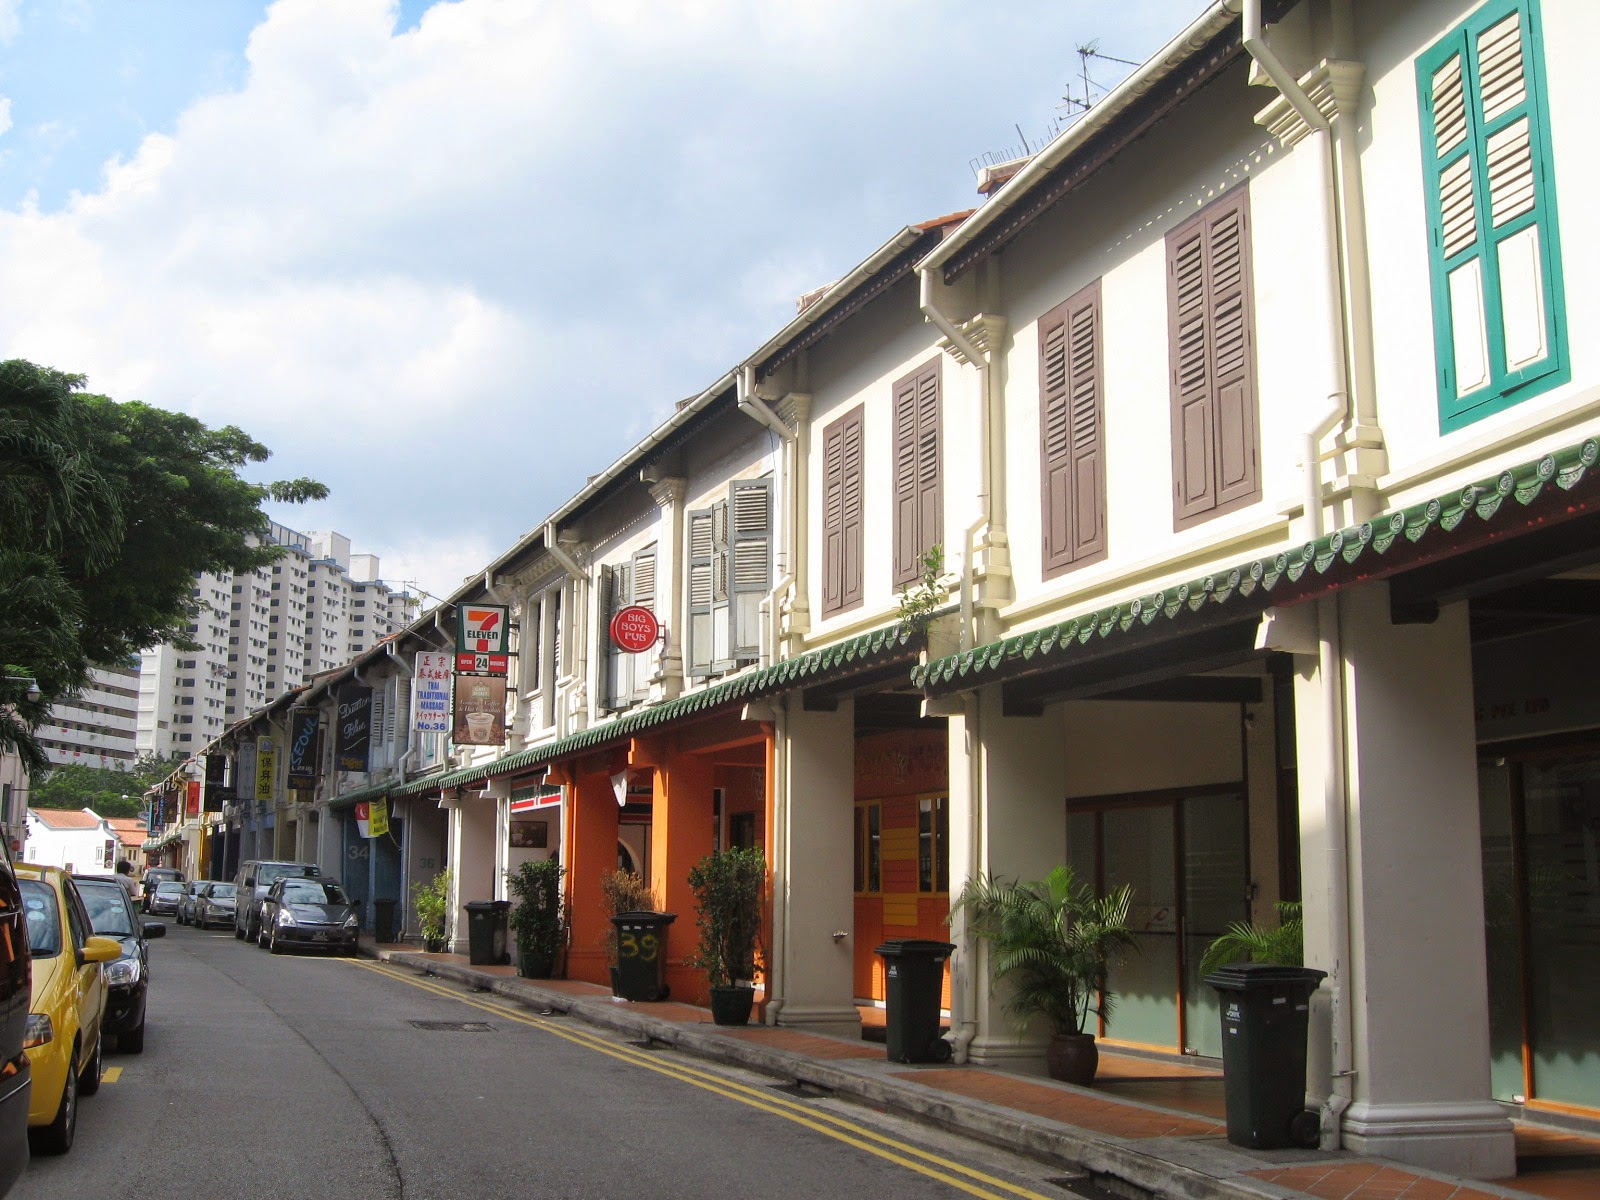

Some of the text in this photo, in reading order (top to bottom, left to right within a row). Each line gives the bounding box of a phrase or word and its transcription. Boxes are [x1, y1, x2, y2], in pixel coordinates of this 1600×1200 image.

[627, 613, 646, 623] BIG
[467, 610, 499, 652] 7
[621, 622, 651, 633] BOYS
[624, 632, 647, 642] PUB
[475, 657, 488, 669] 24
[427, 681, 440, 690] THAI
[417, 690, 450, 701] TRADITIONAL
[420, 701, 445, 711] MASSAGE
[417, 721, 446, 731] No.36
[290, 717, 318, 767] SEOUL
[347, 845, 370, 860] 34
[621, 932, 659, 961] 39
